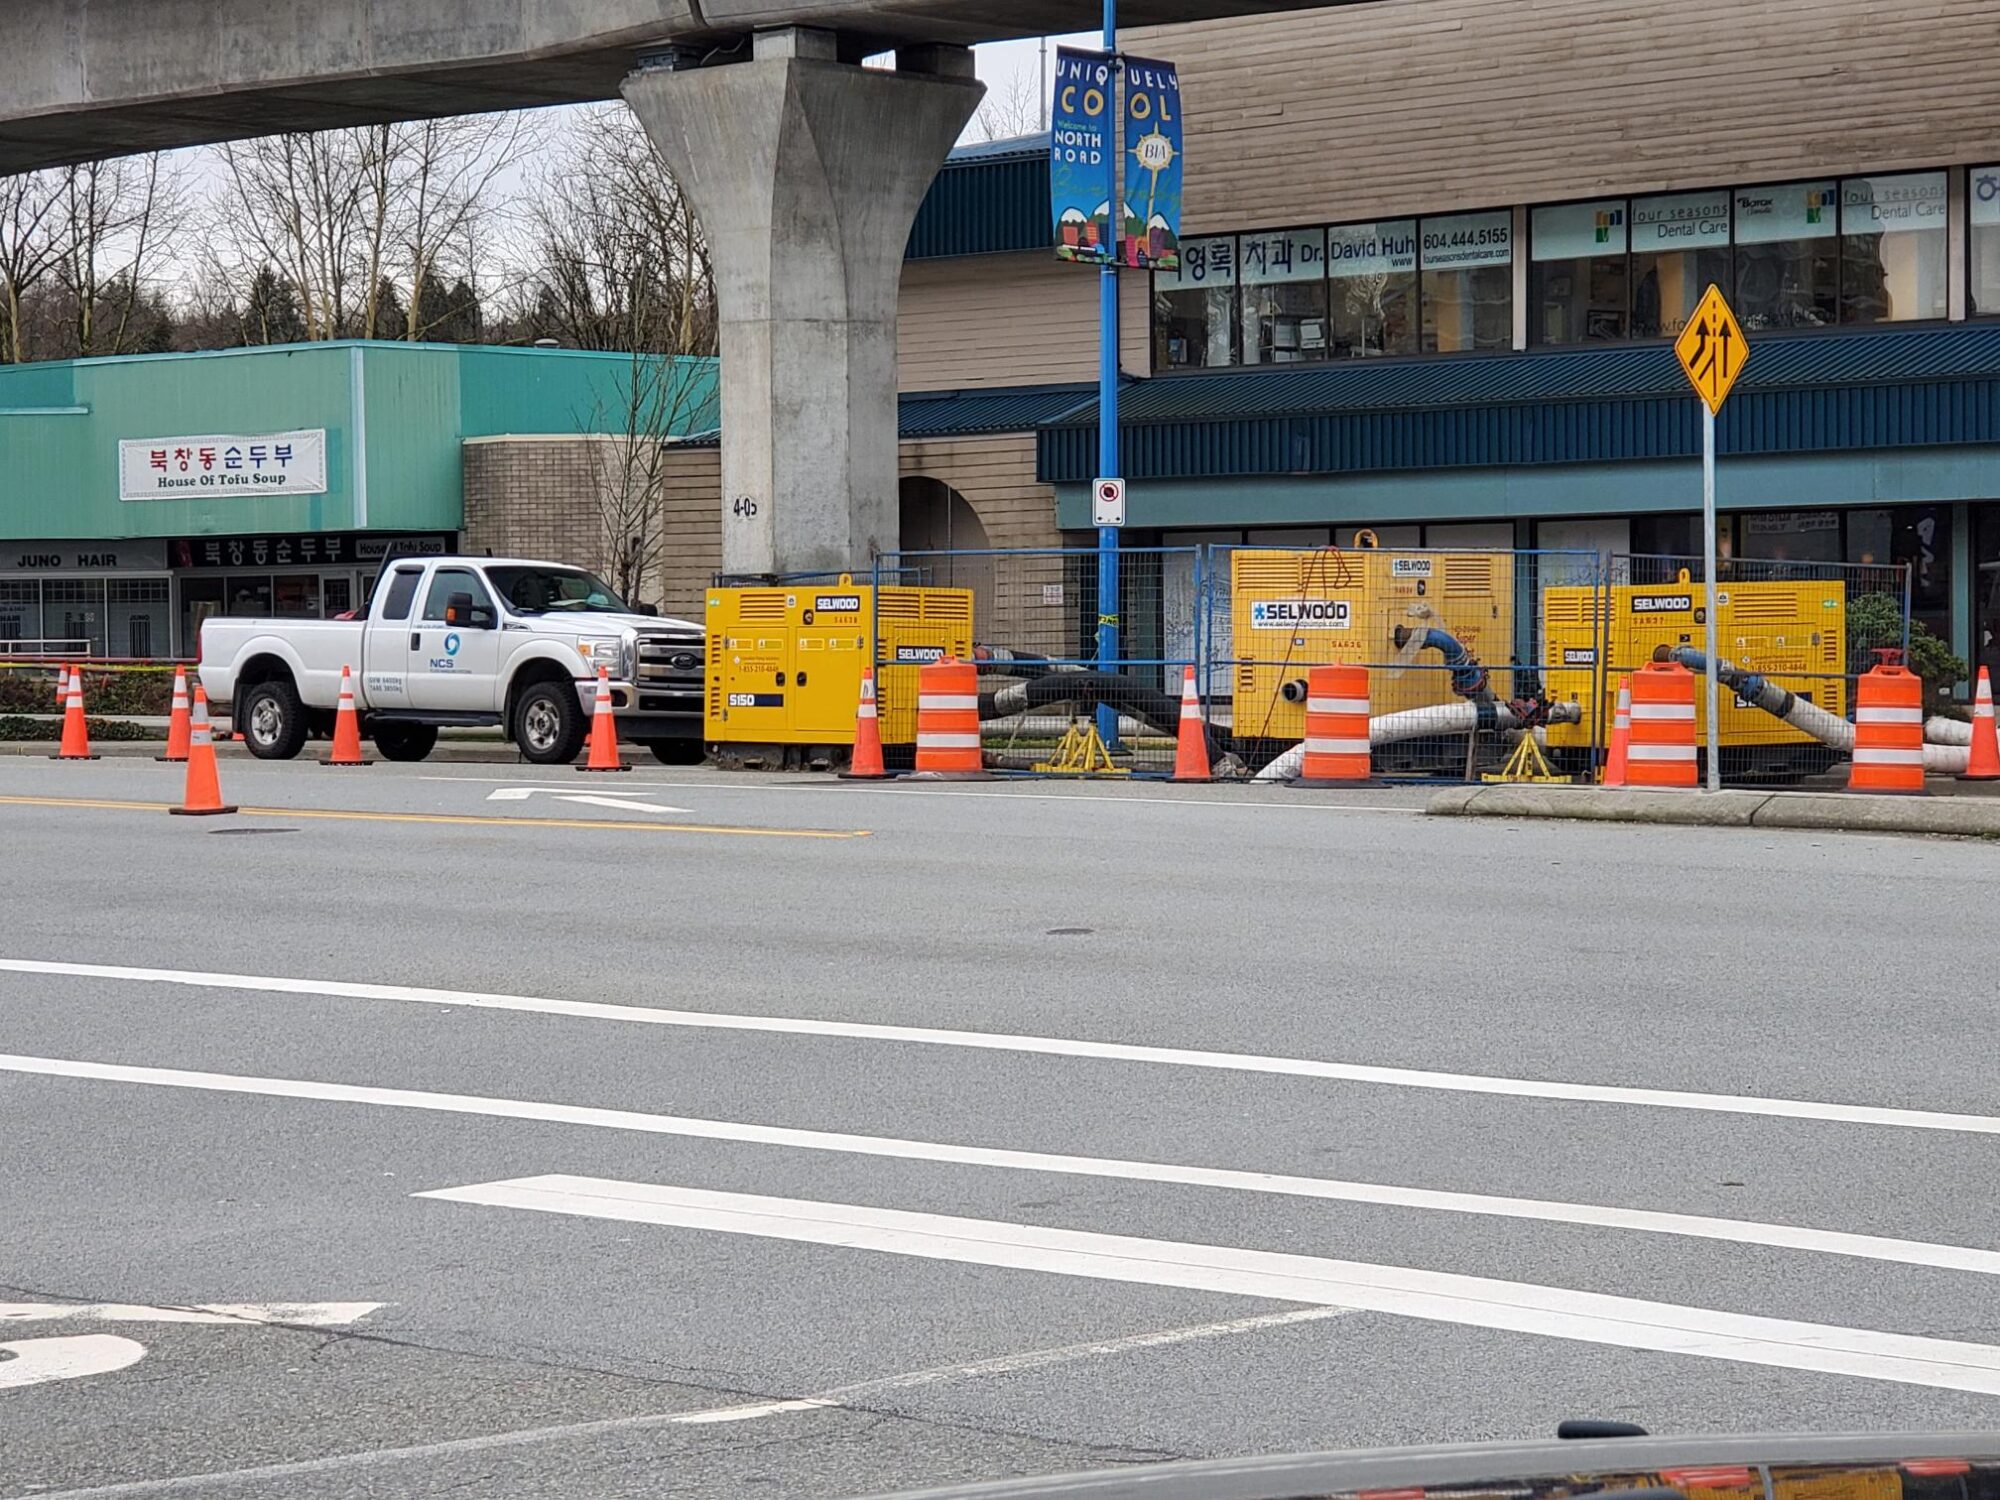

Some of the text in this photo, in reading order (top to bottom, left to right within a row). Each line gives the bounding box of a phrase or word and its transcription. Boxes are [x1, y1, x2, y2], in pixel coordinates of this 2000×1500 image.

[1056, 58, 1108, 86] UNIQ
[1061, 85, 1171, 121] CO OL
[1054, 129, 1101, 148] NORTH
[1054, 147, 1101, 165] ROAD
[1144, 143, 1166, 159] BIA
[1670, 203, 1728, 219] seasons
[1871, 202, 1946, 221] Dental Care
[1657, 219, 1728, 239] Dental Care
[1423, 227, 1508, 250] 604.444.5155
[1301, 235, 1415, 263] Dr. David Huh
[157, 473, 286, 488] House Of Tofu Soup
[17, 553, 117, 568] JUNO HAIR
[1398, 560, 1431, 571] SELWOOD
[816, 597, 858, 611] SELWOOD
[1266, 603, 1348, 620] SELWOOD
[1634, 596, 1690, 611] SELWOOD
[897, 647, 944, 660] SELWOOD
[1564, 650, 1595, 663] SELWOO
[430, 658, 454, 668] NCS
[729, 694, 755, 706] S150
